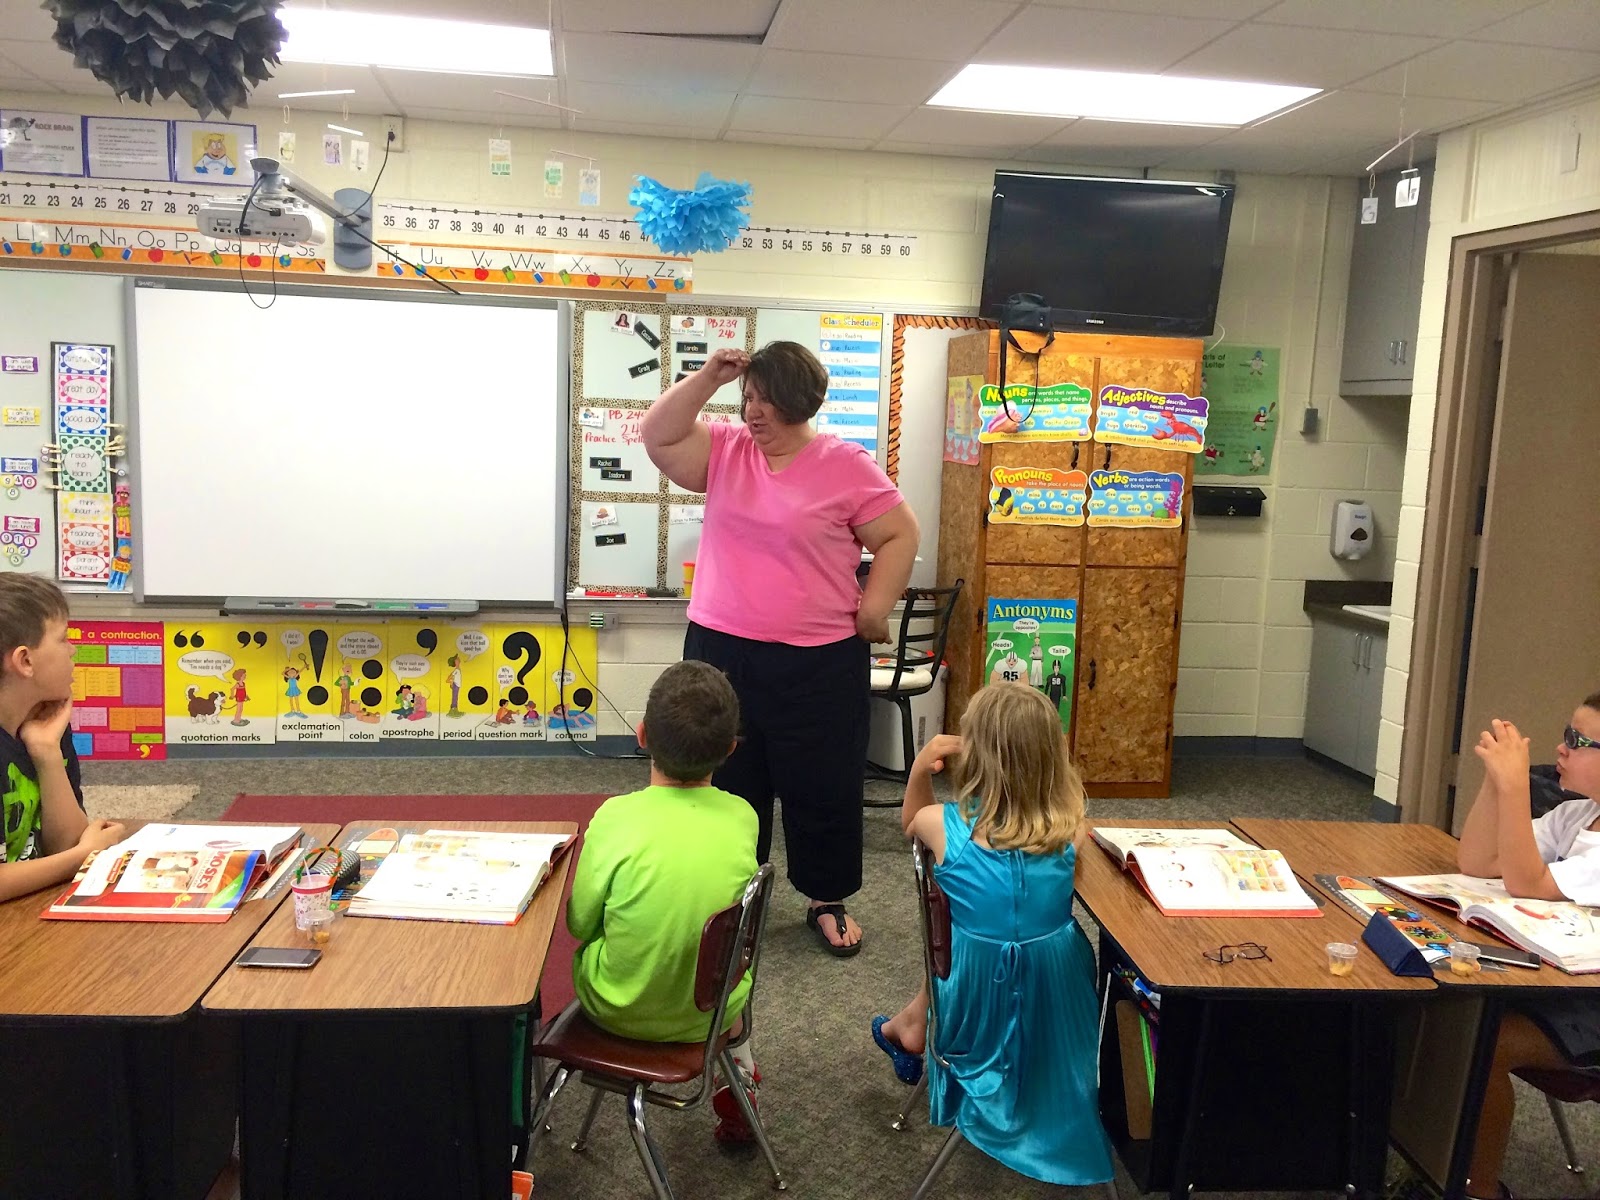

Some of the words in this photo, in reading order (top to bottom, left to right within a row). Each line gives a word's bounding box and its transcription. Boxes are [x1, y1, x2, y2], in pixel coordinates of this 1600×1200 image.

[53, 124, 74, 132] BRAIN
[0, 193, 11, 205] 21
[23, 194, 36, 206] 22
[47, 195, 60, 207] 23
[71, 196, 84, 208] 24
[95, 197, 107, 209] 25
[117, 198, 130, 210] 26
[141, 200, 153, 212] 27
[164, 202, 177, 214] 28
[187, 203, 199, 215] 29
[383, 215, 395, 227] 35
[405, 217, 417, 228] 36
[428, 219, 440, 230] 37
[450, 220, 462, 232] 38
[471, 221, 483, 233] 39
[493, 223, 505, 234] 40
[515, 224, 524, 235] 41
[536, 225, 547, 237] 42
[557, 226, 568, 238] 43
[577, 227, 589, 239] 44
[599, 229, 610, 240] 45
[619, 230, 631, 241] 46
[742, 237, 753, 248] 52
[762, 238, 773, 249] 53
[782, 239, 793, 250] 54
[802, 240, 813, 251] 55
[821, 241, 832, 253] 56
[841, 242, 852, 253] 57
[861, 243, 872, 254] 58
[880, 244, 891, 255] 59
[899, 245, 910, 256] 60
[707, 318, 718, 328] PB
[719, 318, 738, 328] 239
[718, 329, 735, 339] 240
[1102, 389, 1166, 406] Adjectives
[609, 409, 623, 420] PB
[621, 423, 641, 436] 24
[585, 431, 617, 443] Practice
[994, 468, 1053, 484] Pronouns
[1093, 472, 1130, 488] Verbs
[992, 603, 1074, 621] Antonyms
[281, 722, 341, 731] exclamation
[181, 733, 229, 743] quotation
[232, 733, 261, 742] marks
[298, 731, 323, 741] point
[349, 731, 374, 740] colon
[382, 728, 434, 738] apostrophe
[443, 730, 472, 739] period
[479, 730, 517, 740] question
[520, 730, 543, 738] mark
[555, 731, 588, 739] comma
